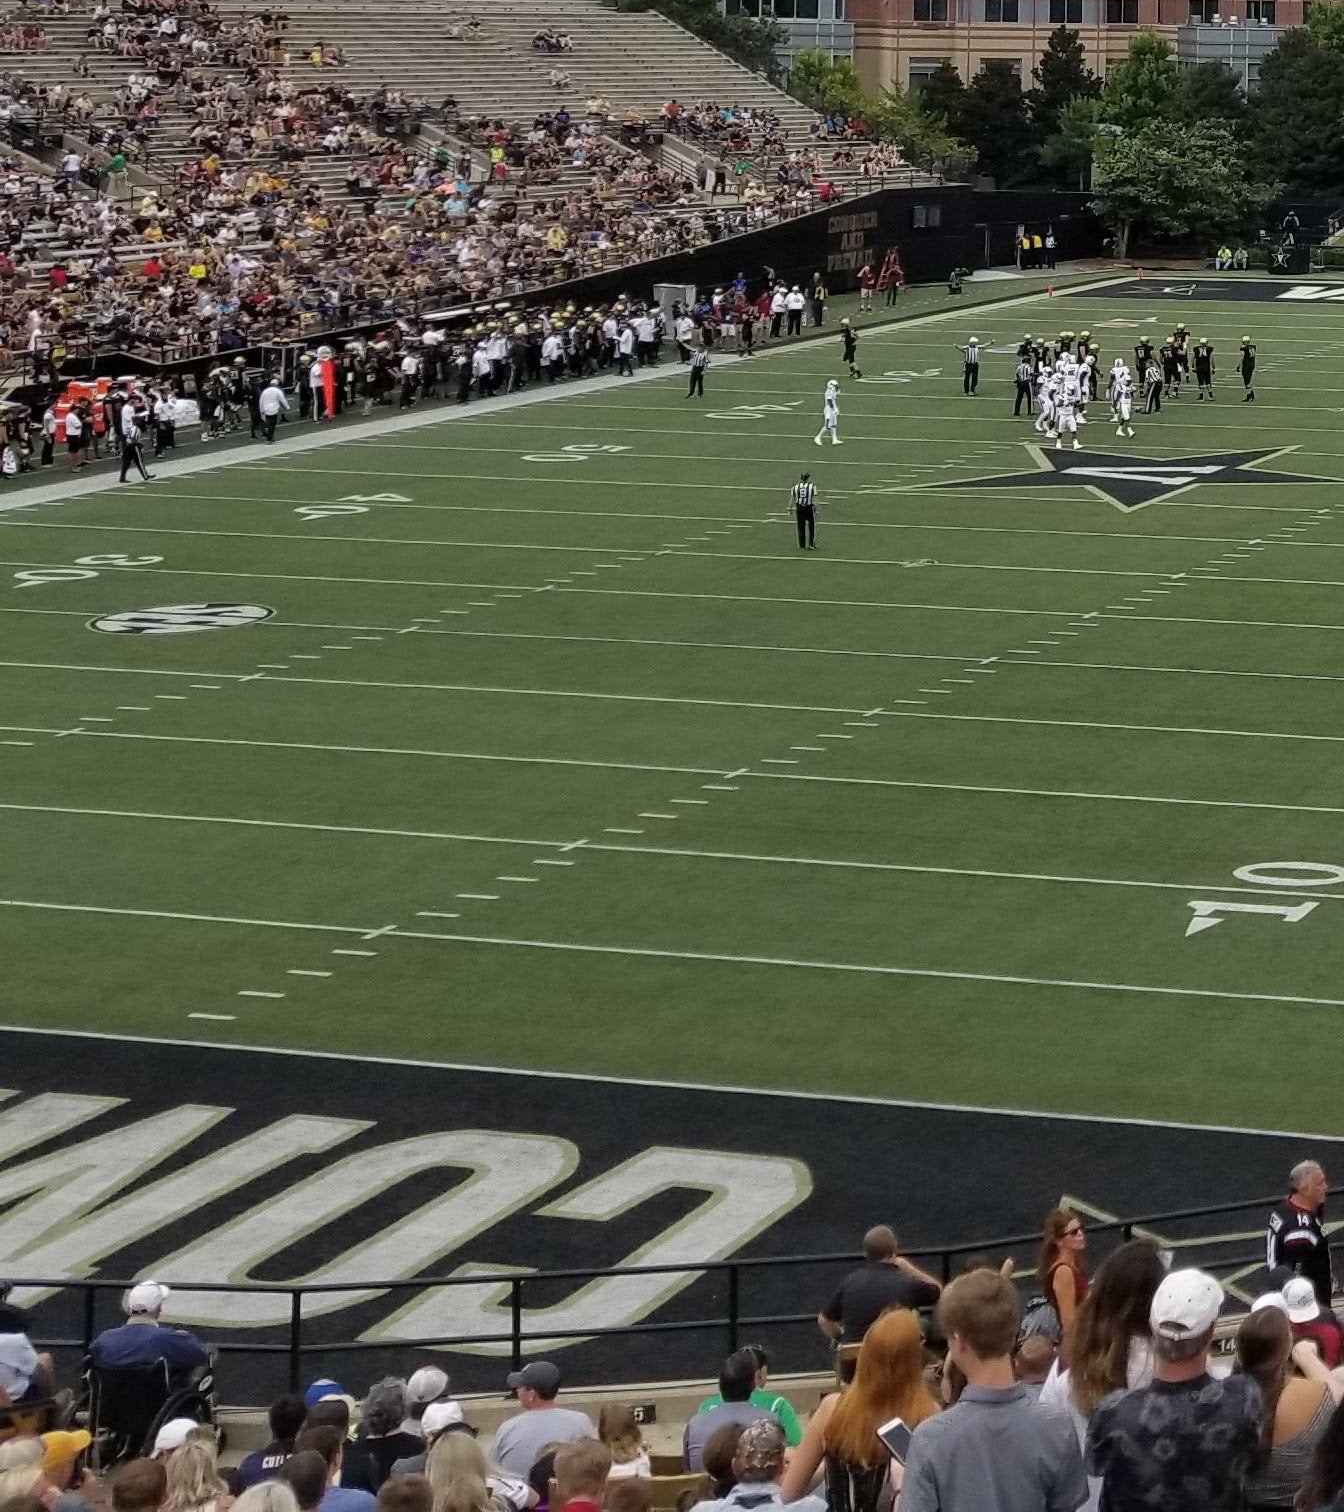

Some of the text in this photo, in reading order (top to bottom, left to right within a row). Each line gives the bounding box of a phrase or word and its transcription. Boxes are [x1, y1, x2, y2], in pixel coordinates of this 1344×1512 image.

[521, 444, 632, 462] 50
[293, 492, 413, 516] 40
[13, 553, 165, 581] 30
[1297, 1214, 1309, 1227] 14
